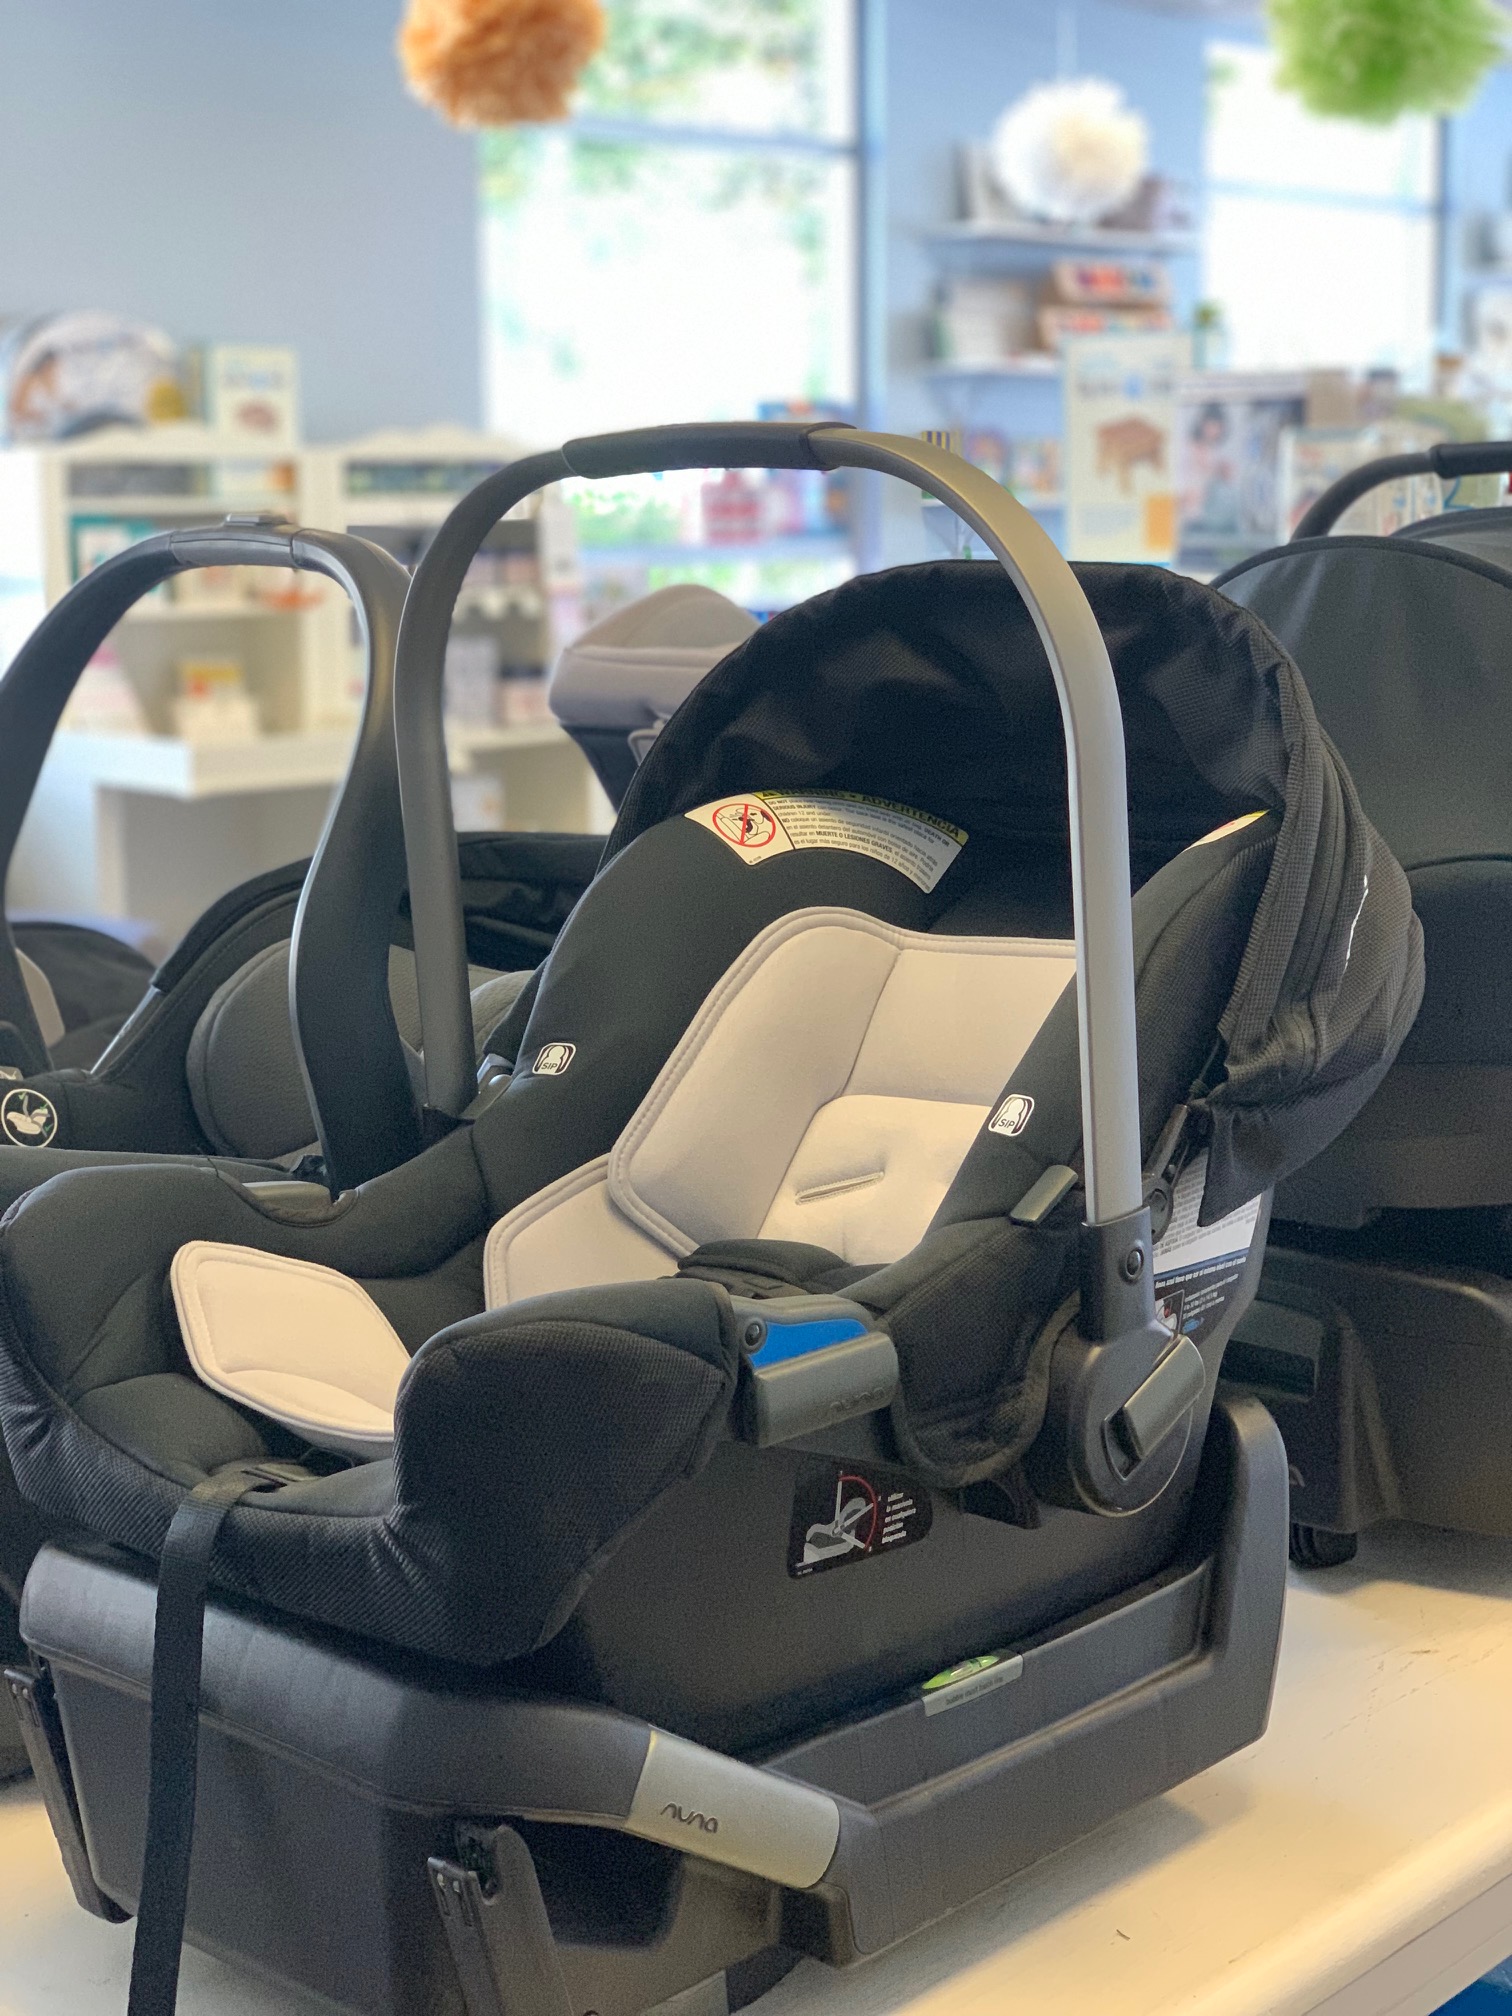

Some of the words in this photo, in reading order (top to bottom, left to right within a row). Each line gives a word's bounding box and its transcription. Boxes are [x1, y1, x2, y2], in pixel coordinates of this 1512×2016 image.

[862, 795, 959, 838] ADVERTENCIA
[846, 820, 871, 831] seguridad
[844, 833, 869, 844] LESIONES
[852, 828, 876, 839] automóvil
[924, 828, 942, 841] DEATH
[941, 838, 950, 847] OR
[870, 848, 883, 857] niños
[541, 1062, 558, 1070] SIP
[998, 1119, 1016, 1128] SIP
[660, 1802, 719, 1834] nuna
